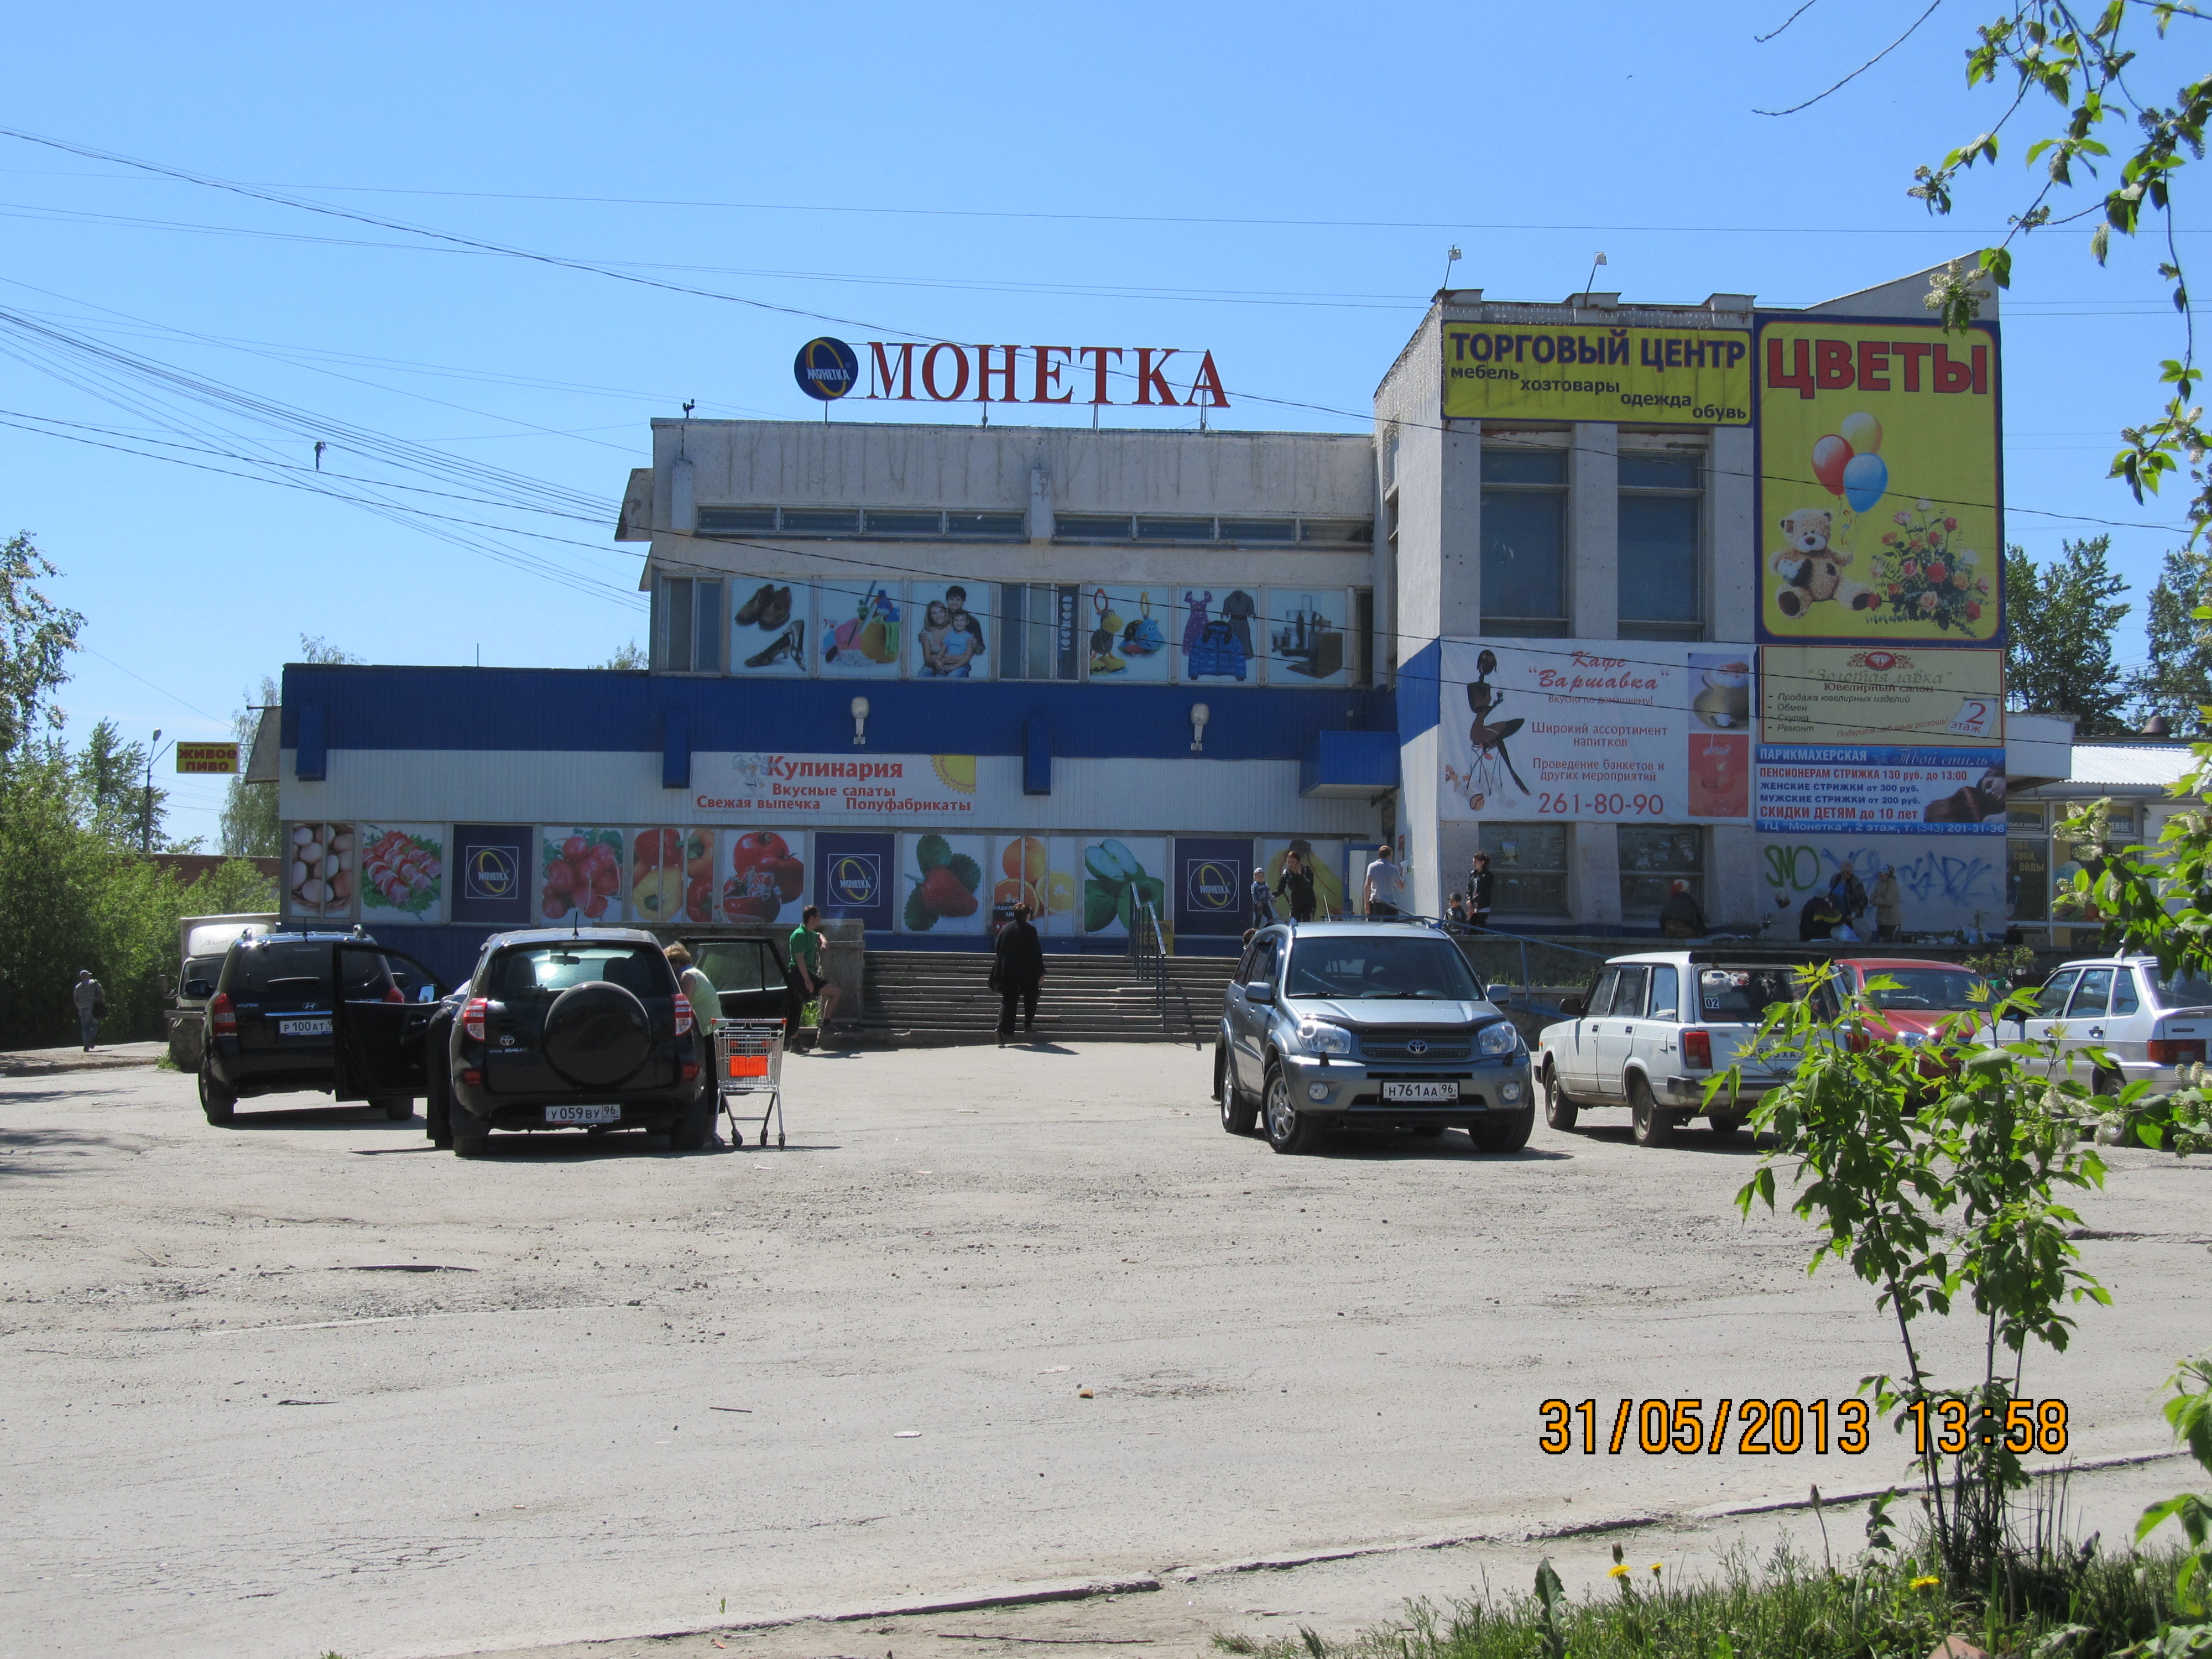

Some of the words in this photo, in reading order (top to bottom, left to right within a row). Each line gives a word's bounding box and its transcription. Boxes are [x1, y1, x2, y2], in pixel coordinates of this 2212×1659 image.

[1449, 329, 1630, 366] ТОРГОВЫЙ
[1641, 338, 1746, 373] ЦЕНТР
[806, 368, 851, 380] МОНЕТКА
[867, 342, 1231, 408] МОНЕТКА
[1767, 338, 1987, 399] ЦВЕТЫ
[1451, 364, 1519, 380] мебель
[1520, 379, 1620, 395] хозтовары
[1621, 393, 1692, 409] одежда
[1692, 404, 1746, 422] обувь
[1571, 650, 1626, 671] Кафе
[1824, 683, 1895, 693] Ювелирный
[1778, 693, 1818, 702] Продажа
[1821, 695, 1871, 703] ювелирных
[1777, 703, 1807, 712] Обмен
[1965, 702, 1986, 724] 2
[1777, 713, 1809, 723] Скупка
[1532, 722, 1588, 735] Широкий
[1593, 726, 1668, 736] ассортимент
[1777, 724, 1814, 733] Ремонт
[1950, 721, 1981, 733] этаж
[1574, 738, 1627, 747] напитков
[1760, 748, 1866, 761] ПАРИКМАХЕРСКАЯ
[767, 756, 902, 781] Кулинария
[1533, 758, 1599, 770] Проведение
[1603, 759, 1653, 770] банкетов
[1540, 772, 1578, 781] других
[1582, 772, 1656, 782] мероприятий
[1760, 768, 1830, 778] ПЕНСИОНЕРАМ
[1834, 769, 1880, 779] СТРИЖКА
[1883, 770, 1900, 780] 130
[1903, 771, 1923, 781] руб.
[1926, 773, 1938, 781] до
[1942, 771, 1968, 780] 13:00
[773, 783, 837, 797] Вкусные
[843, 787, 896, 797] салаты
[1760, 782, 1811, 790] ЖЕНСКИЕ
[1813, 783, 1864, 791] СТРИЖКИ
[697, 795, 752, 808] Свежая
[757, 799, 821, 809] выпечка
[846, 797, 971, 812] Полуфабрикаты
[1537, 792, 1664, 815] 261-80-90
[1815, 795, 1865, 804] СТРИЖКИ
[1760, 806, 1810, 820] СКИДКИ
[1814, 807, 1856, 820] ДЕТЯМ
[1860, 810, 1875, 820] до
[1879, 808, 1893, 819] 10
[1897, 810, 1918, 819] лет
[1763, 821, 1779, 831] ТЦ
[1855, 823, 1863, 831] 2
[1917, 824, 1944, 834] (343)
[1947, 825, 2005, 833] 201-31-36
[1705, 999, 1719, 1008] 02
